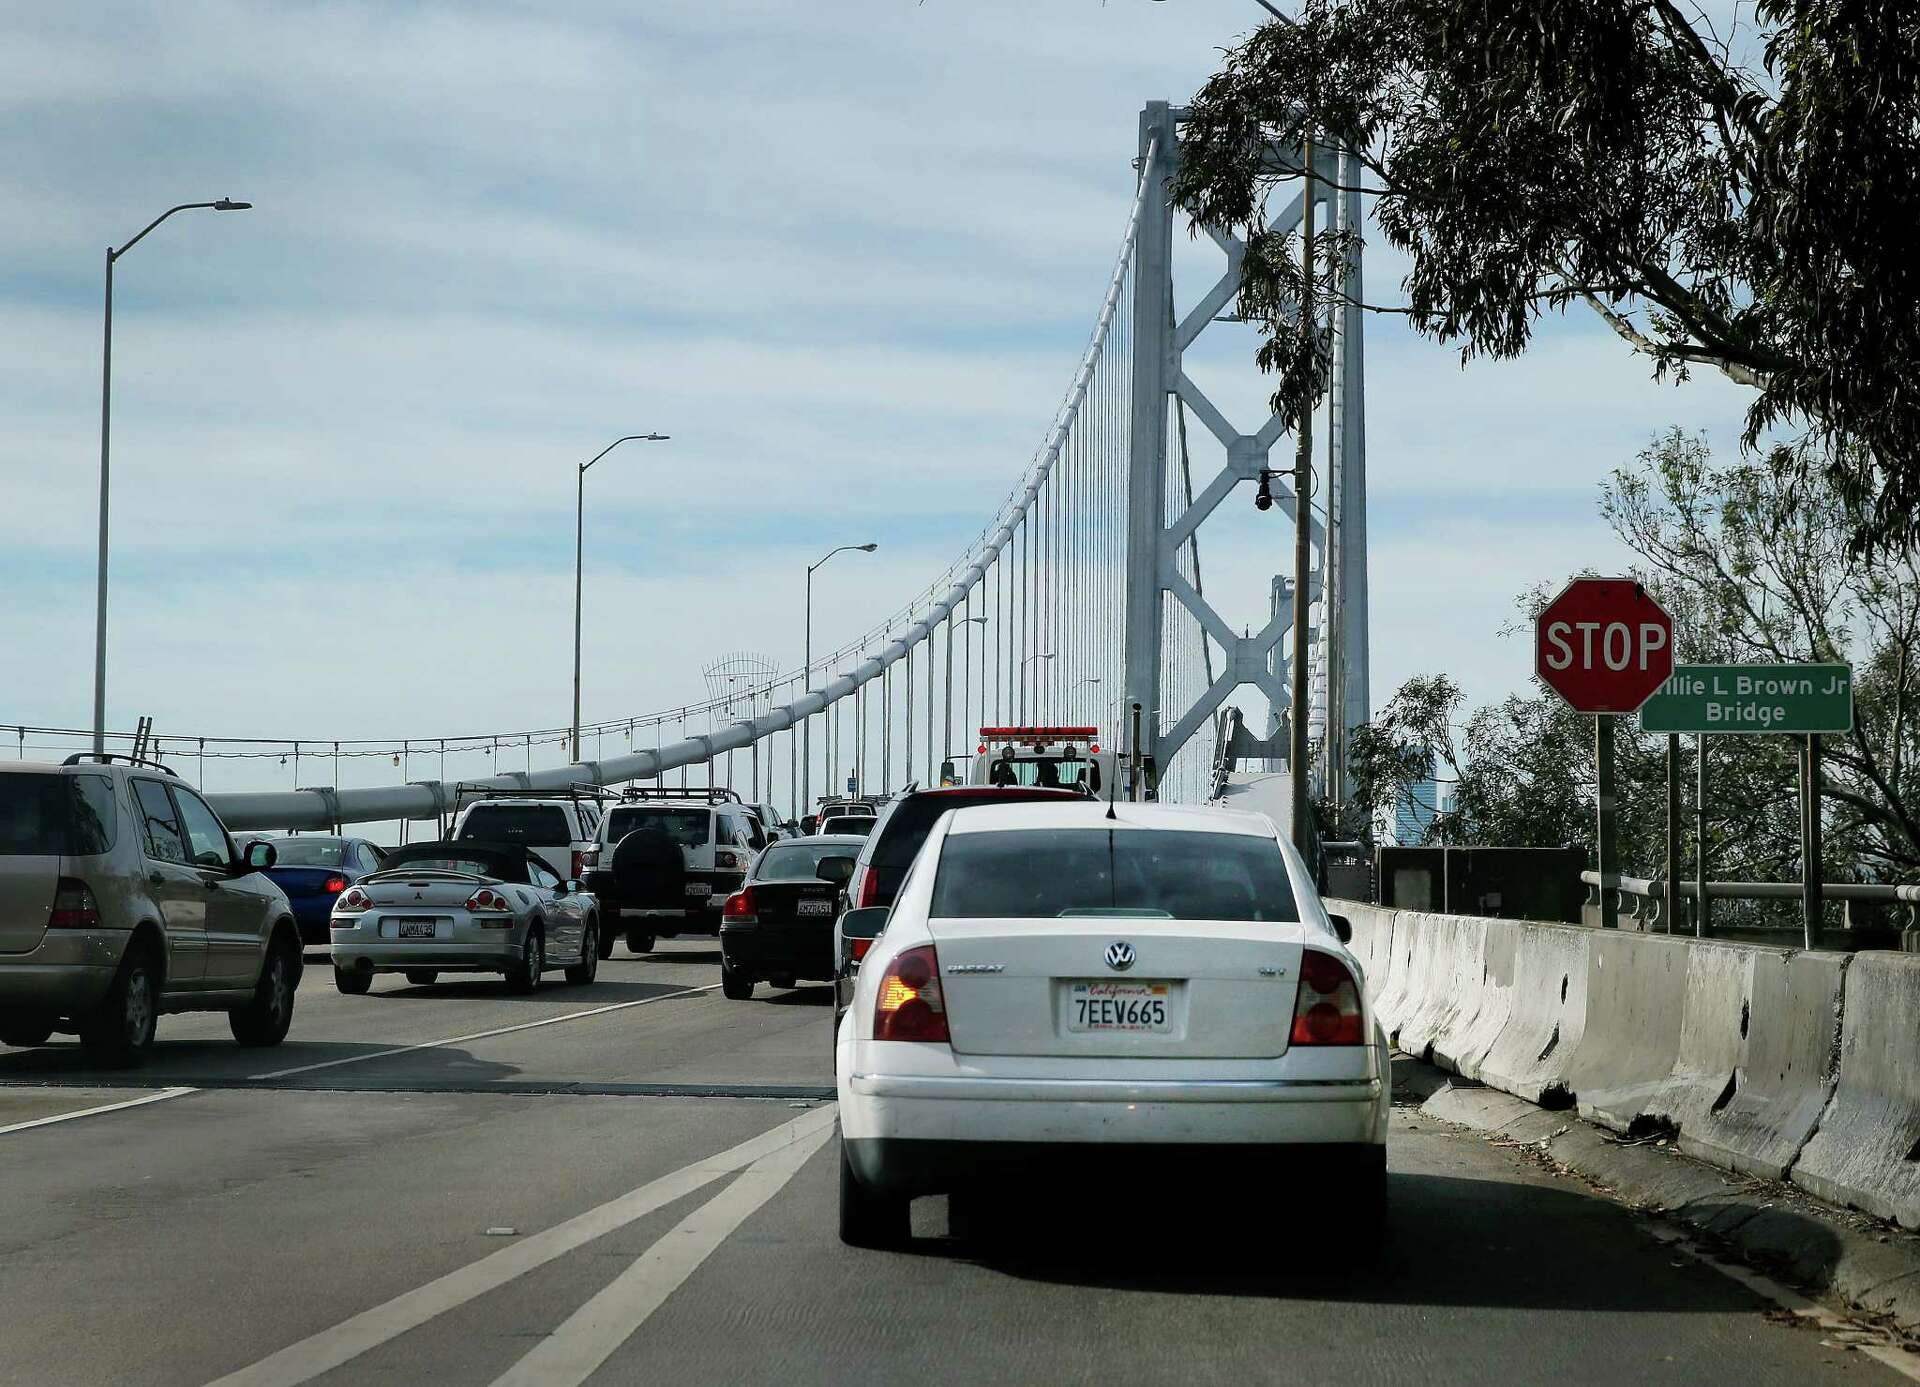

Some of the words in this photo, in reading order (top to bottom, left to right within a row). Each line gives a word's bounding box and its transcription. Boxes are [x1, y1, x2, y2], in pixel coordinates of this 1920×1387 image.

[1546, 621, 1667, 671] STOP
[1656, 675, 1705, 695] illie
[1713, 676, 1728, 695] L
[1736, 676, 1813, 695] Brown
[1821, 676, 1848, 695] Jr
[1706, 702, 1786, 727] Bridge
[1088, 983, 1152, 998] California
[1075, 999, 1165, 1024] 7EEV665
